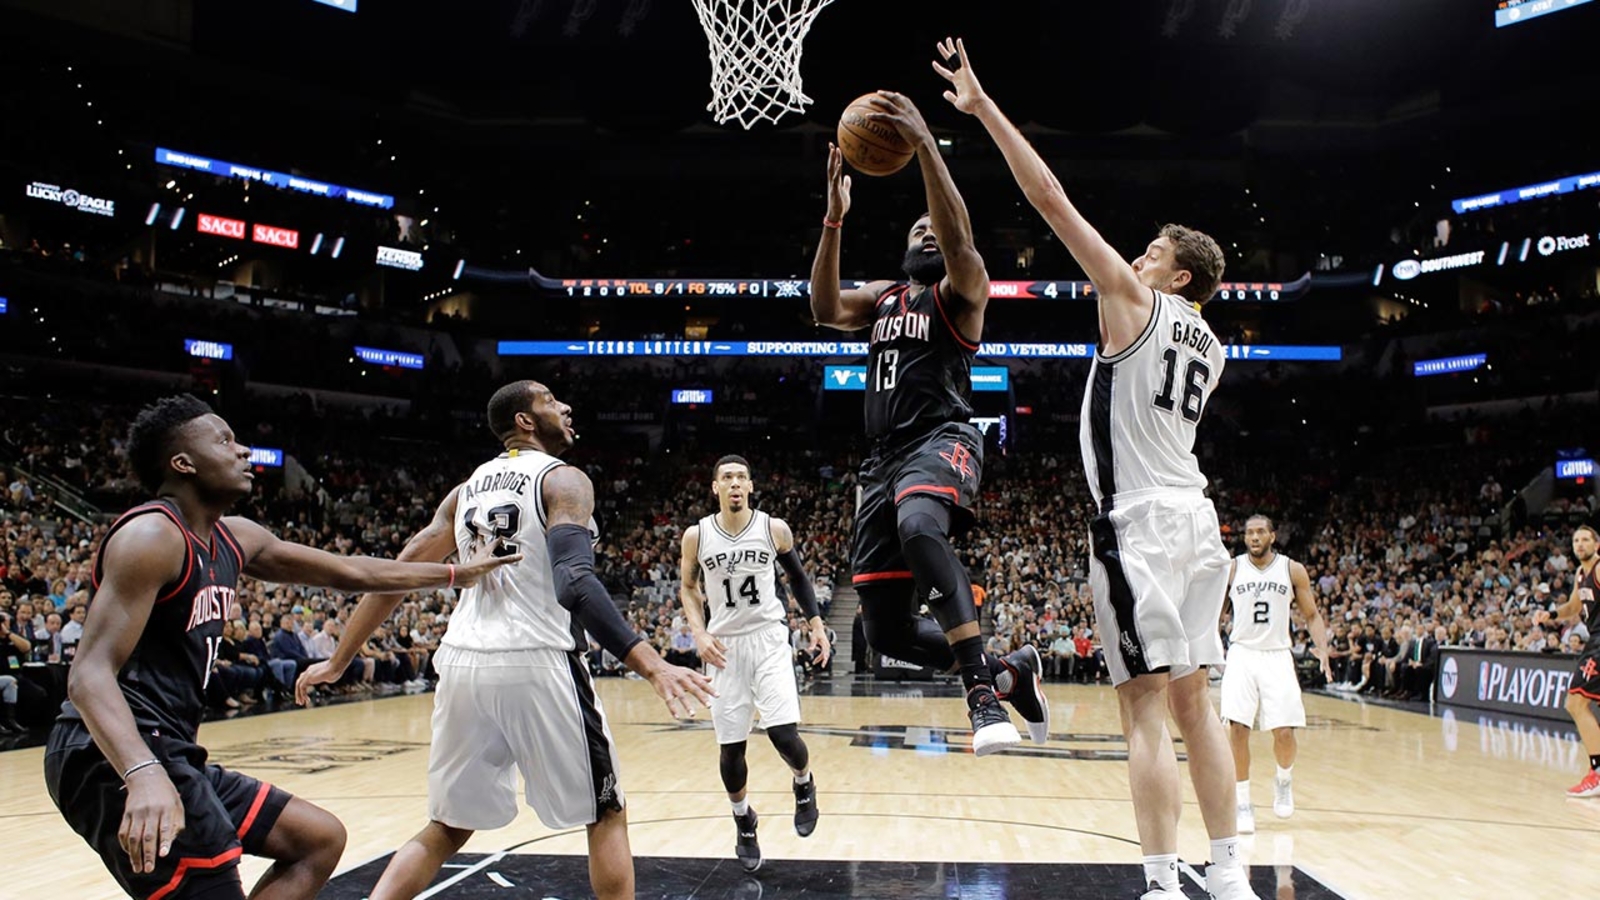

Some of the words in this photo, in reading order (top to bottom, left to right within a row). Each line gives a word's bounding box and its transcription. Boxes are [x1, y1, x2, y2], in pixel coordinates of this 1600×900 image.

[26, 185, 63, 202] LUCKY
[80, 194, 114, 212] EAGLE
[200, 215, 244, 237] SACU
[256, 226, 298, 247] SACU
[1556, 233, 1590, 251] Frost
[1420, 251, 1485, 273] SOUTHWEST
[567, 287, 574, 296] 1
[583, 287, 591, 296] 2
[600, 287, 608, 296] 0
[617, 287, 625, 296] 0
[628, 283, 652, 294] TOL
[688, 283, 705, 294] FG
[708, 283, 736, 294] 75%
[739, 283, 747, 294] F
[750, 283, 759, 294] 0
[990, 285, 1018, 296] HOU
[1044, 282, 1058, 299] 4
[1083, 285, 1092, 296] F
[1221, 290, 1229, 300] 0
[1237, 290, 1245, 300] 0
[1270, 290, 1279, 300] 0
[588, 341, 634, 354] TEXAS
[644, 341, 711, 354] LOTTERY
[747, 342, 837, 354] SUPPORTING
[840, 342, 869, 354] TEX
[976, 343, 1006, 355] AND
[1009, 344, 1087, 356] VETERANS
[1172, 321, 1213, 358] GASOL
[875, 349, 899, 392] 13
[1151, 346, 1210, 424] 16
[466, 471, 531, 501] ALDRIDGE
[704, 550, 770, 574] SPURS
[722, 575, 760, 608] 14
[1236, 581, 1288, 598] SPURS
[1254, 601, 1269, 624] 2
